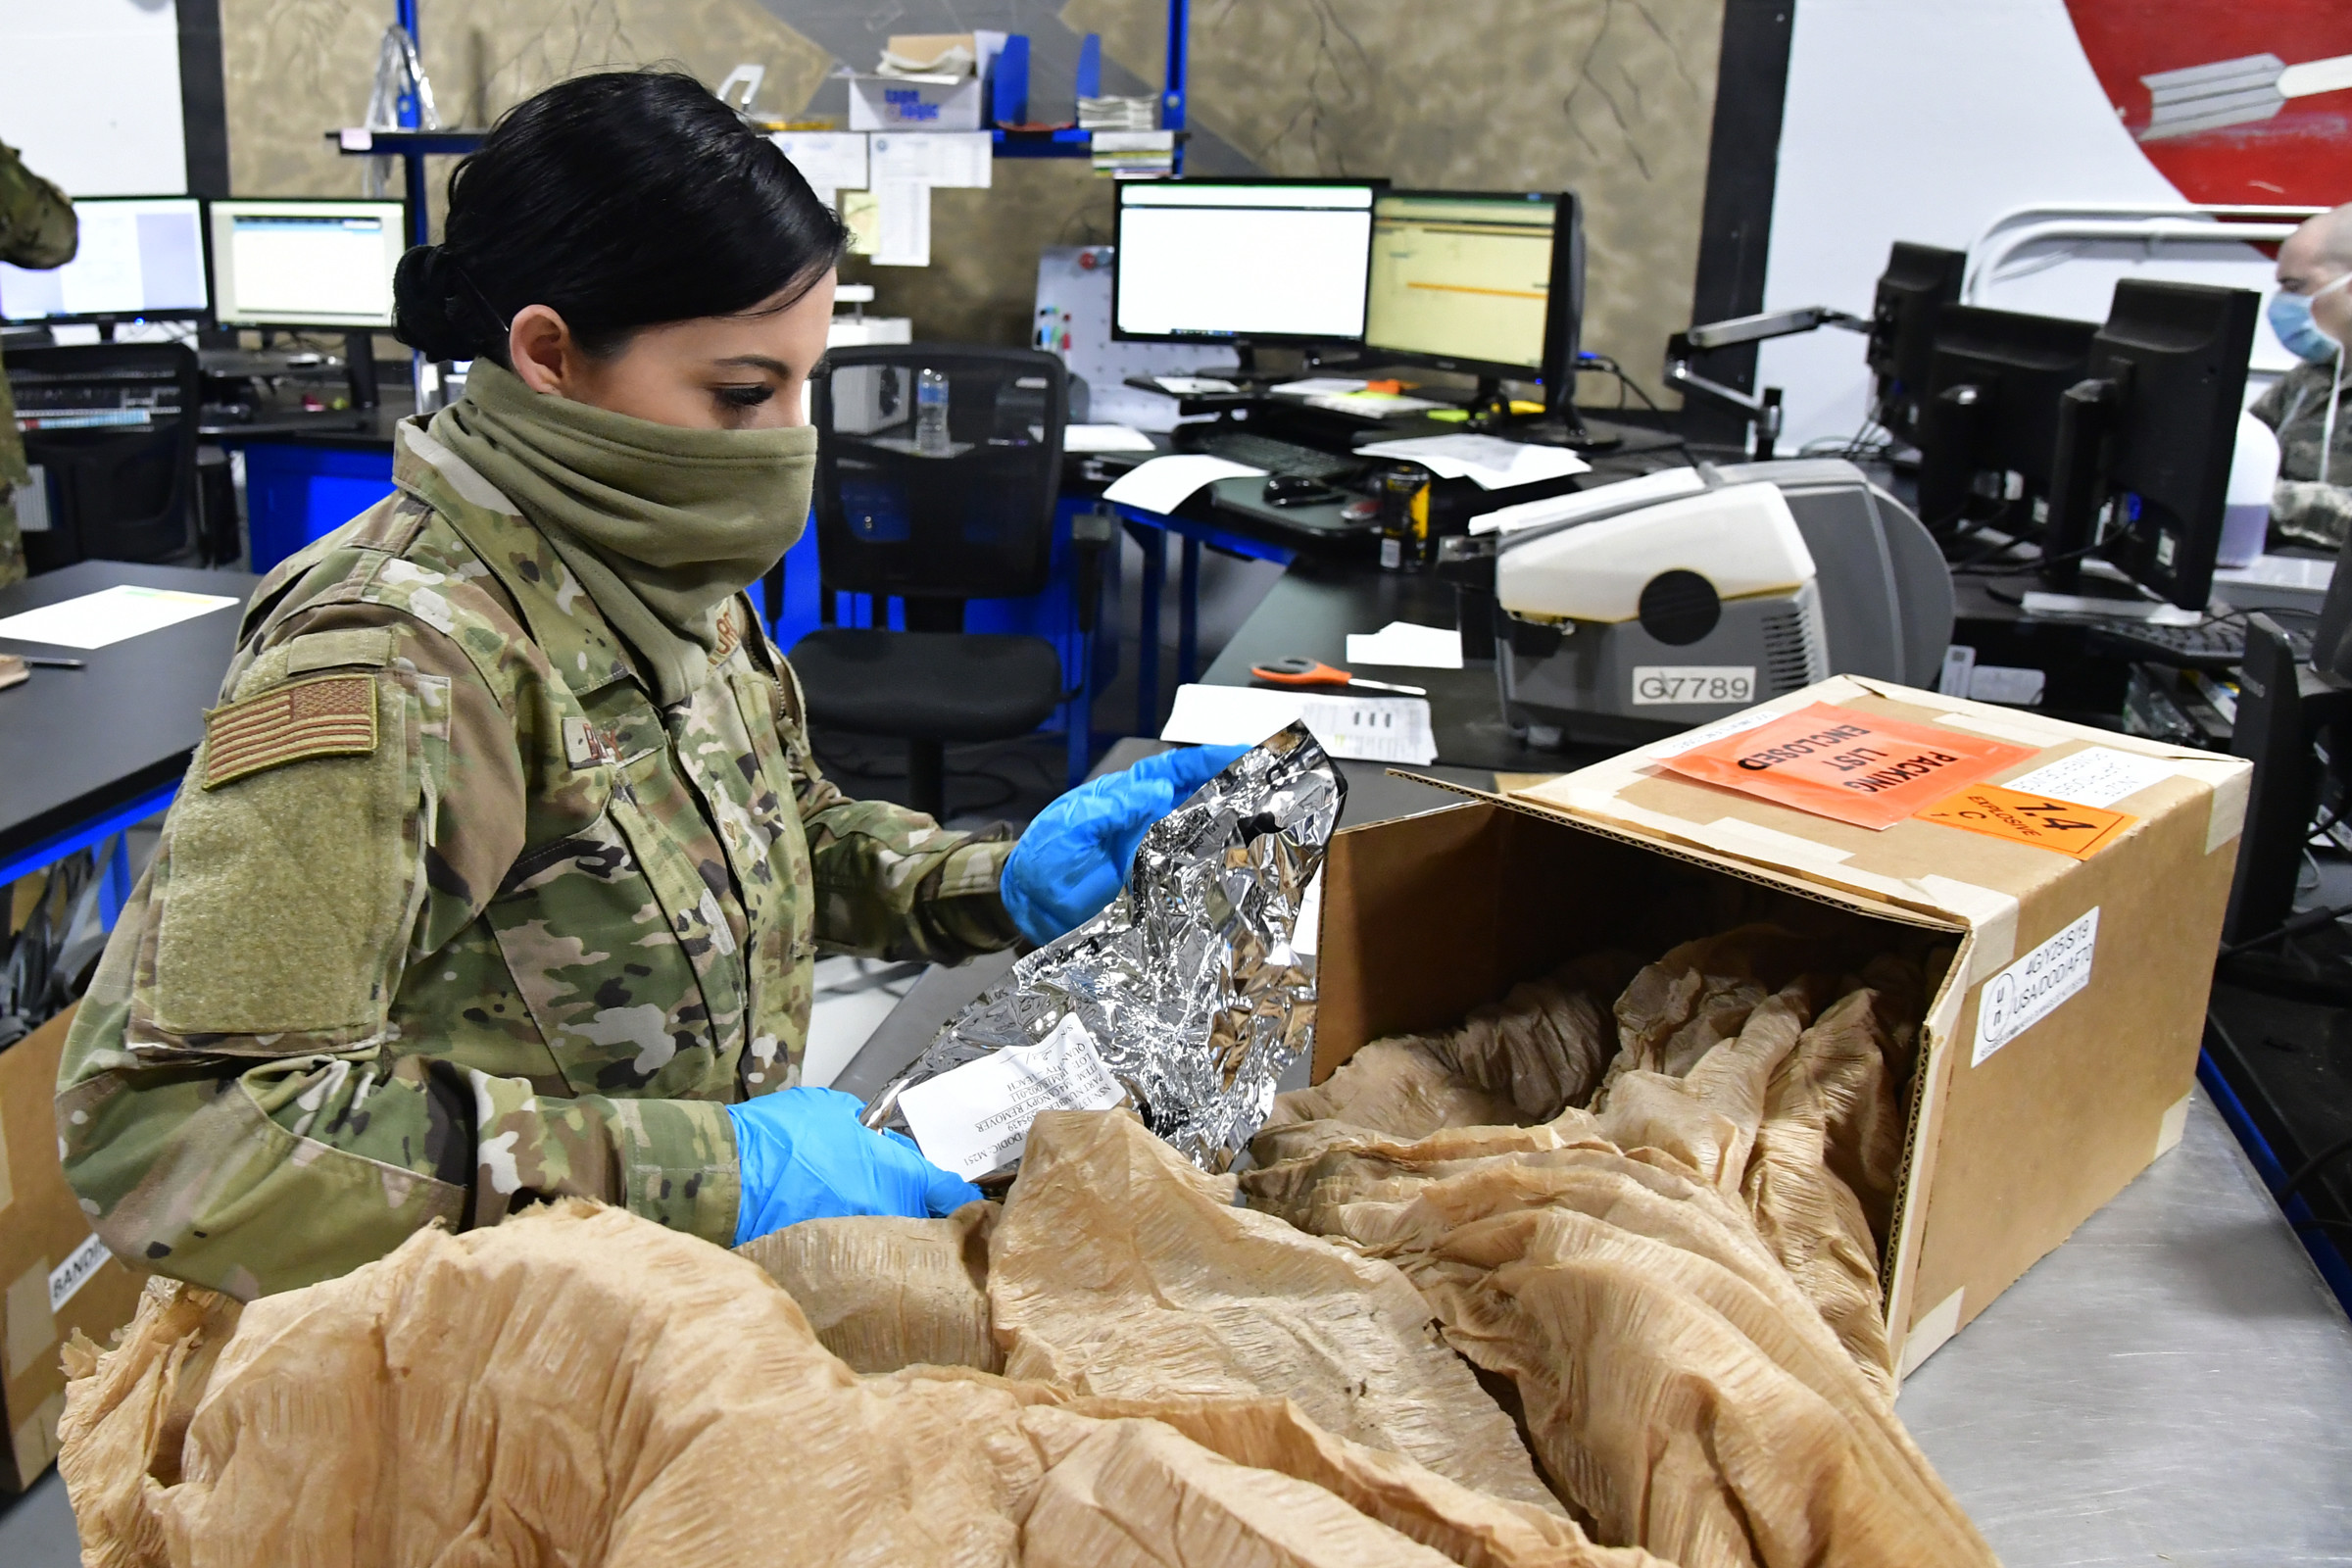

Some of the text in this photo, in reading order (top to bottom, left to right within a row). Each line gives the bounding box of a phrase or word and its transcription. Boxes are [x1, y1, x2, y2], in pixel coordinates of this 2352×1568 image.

[1640, 677, 1748, 699] G7789
[1737, 724, 1871, 771] ENCLOSED
[1822, 748, 1888, 771] LIST
[1842, 751, 1960, 792] PACKING
[1958, 810, 1987, 820] C
[1967, 795, 2042, 837] EXPLOSIVE
[2014, 802, 2099, 831] 1.4
[1073, 1053, 1093, 1069] LOT:
[1076, 1062, 1098, 1083] ITEM:
[1006, 1075, 1034, 1092] EACH
[1083, 1073, 1103, 1090] PART
[1091, 1084, 1111, 1102] NSN:
[1026, 1088, 1060, 1111] CANOPY
[975, 1104, 1025, 1133] REMOVER
[963, 1132, 1023, 1166] DODIC: M251
